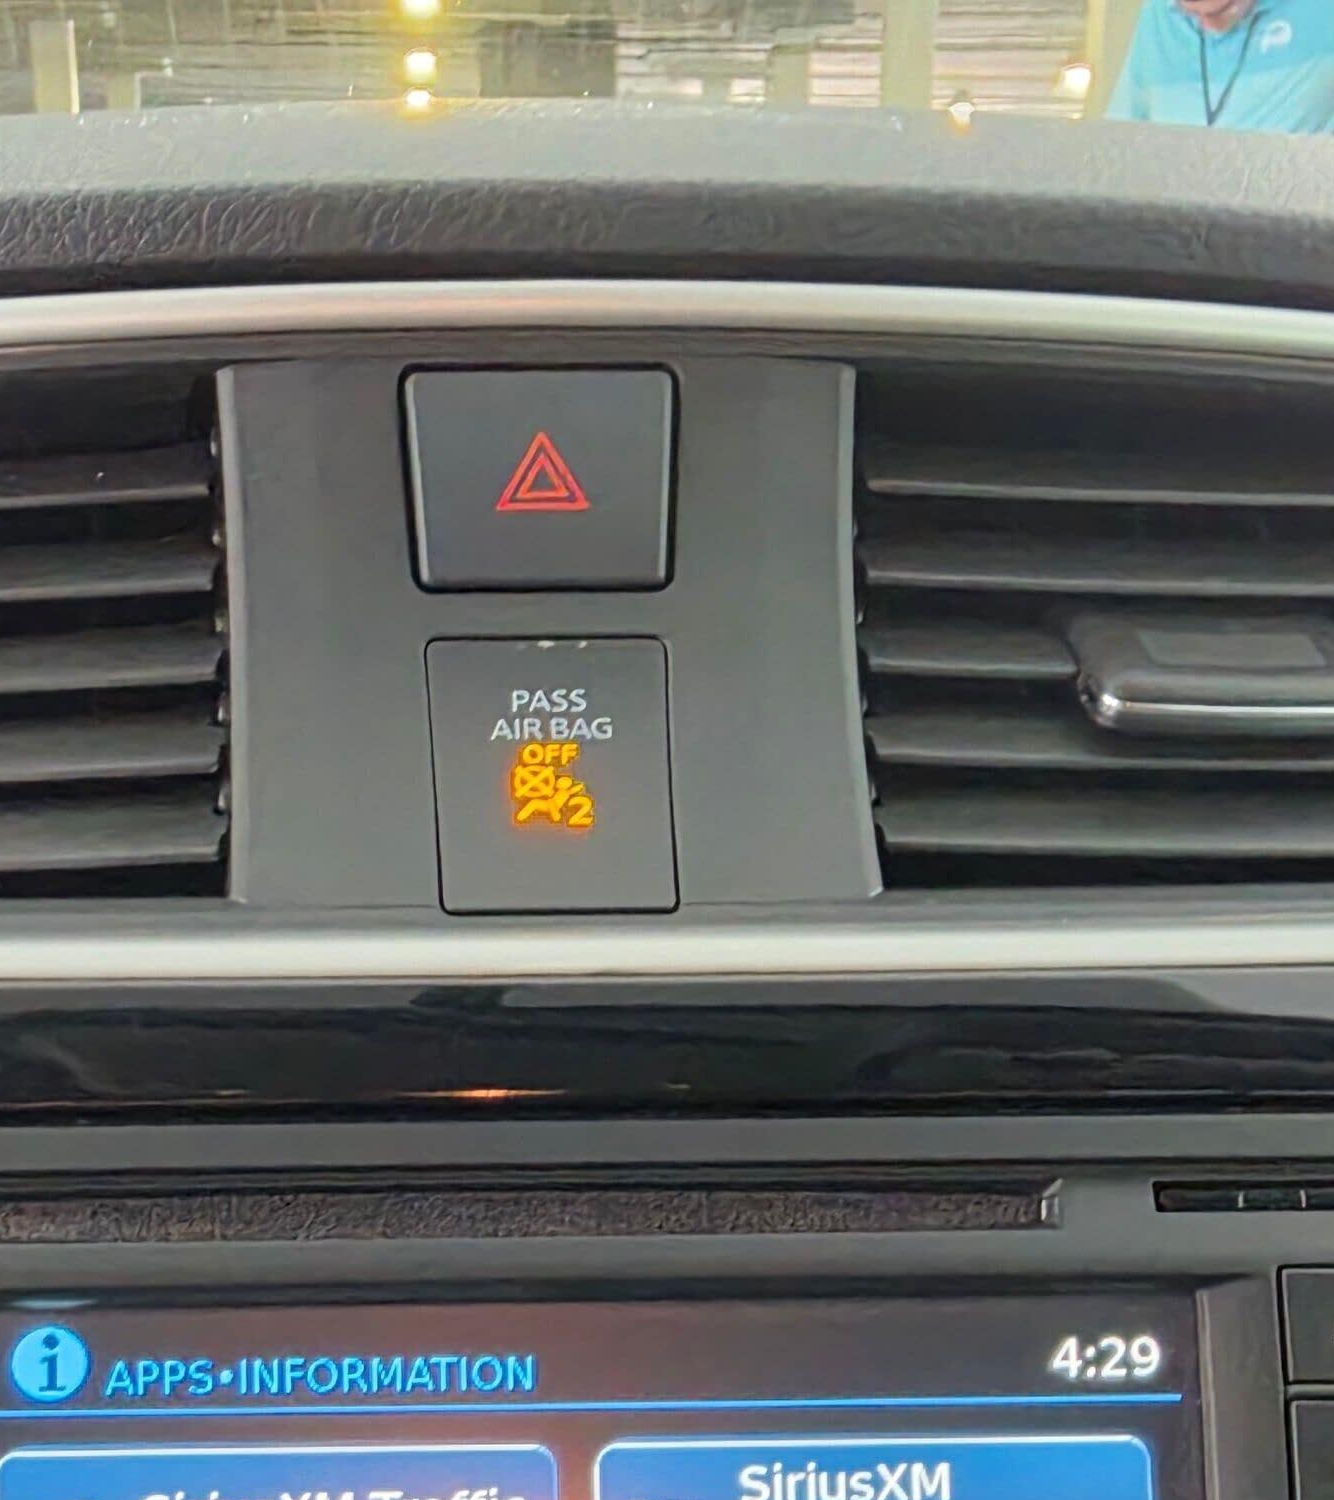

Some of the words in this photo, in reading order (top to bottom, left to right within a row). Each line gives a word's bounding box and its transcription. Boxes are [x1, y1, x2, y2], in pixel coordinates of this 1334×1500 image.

[511, 688, 587, 713] PASS
[490, 717, 543, 741] AIR
[549, 717, 613, 741] BAG
[521, 742, 579, 765] OFF
[1050, 1336, 1161, 1380] 4:29
